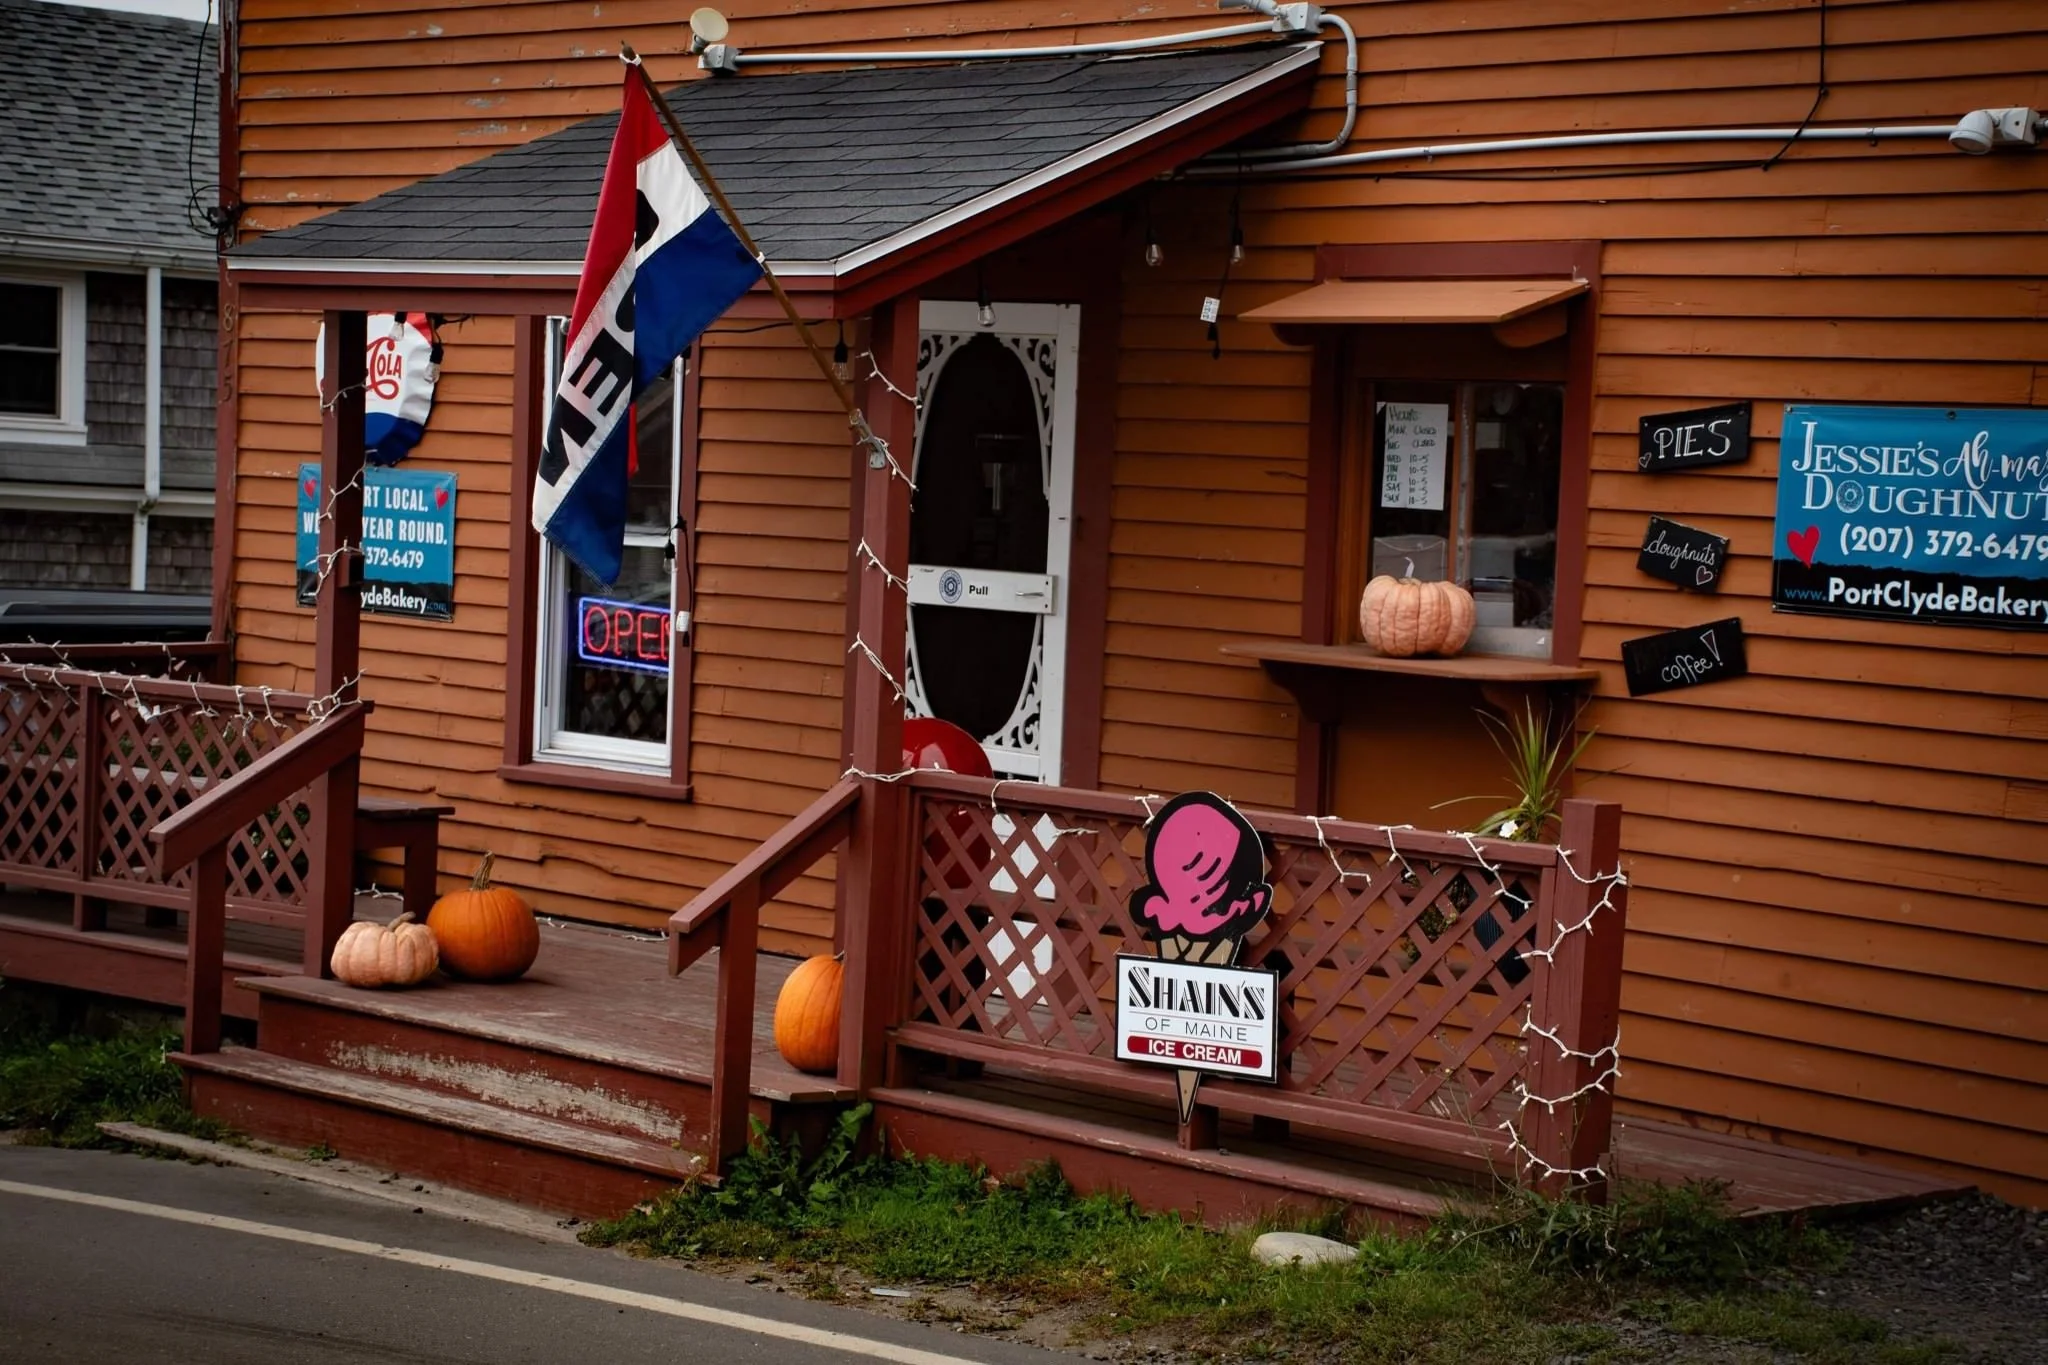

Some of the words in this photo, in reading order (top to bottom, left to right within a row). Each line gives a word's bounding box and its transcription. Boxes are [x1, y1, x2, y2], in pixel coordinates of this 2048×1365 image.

[1653, 419, 1731, 459] PIES
[1792, 421, 1940, 477] JESSIE'S
[385, 487, 429, 512] LOCAL.
[362, 516, 393, 540] YEAR
[399, 519, 448, 545] ROUND.
[1840, 522, 1914, 559] (207)
[1924, 529, 2048, 561] 372-6479
[366, 546, 424, 569] 372-6479
[1643, 530, 1715, 569] doughnuts
[969, 585, 988, 596] Pull
[1661, 629, 1724, 683] coffee!
[1127, 966, 1265, 1021] SHAIN'S
[1145, 1016, 1171, 1032] OF
[1185, 1021, 1248, 1041] MAINE
[1148, 1039, 1176, 1057] ICE
[1182, 1043, 1242, 1065] CREAM
